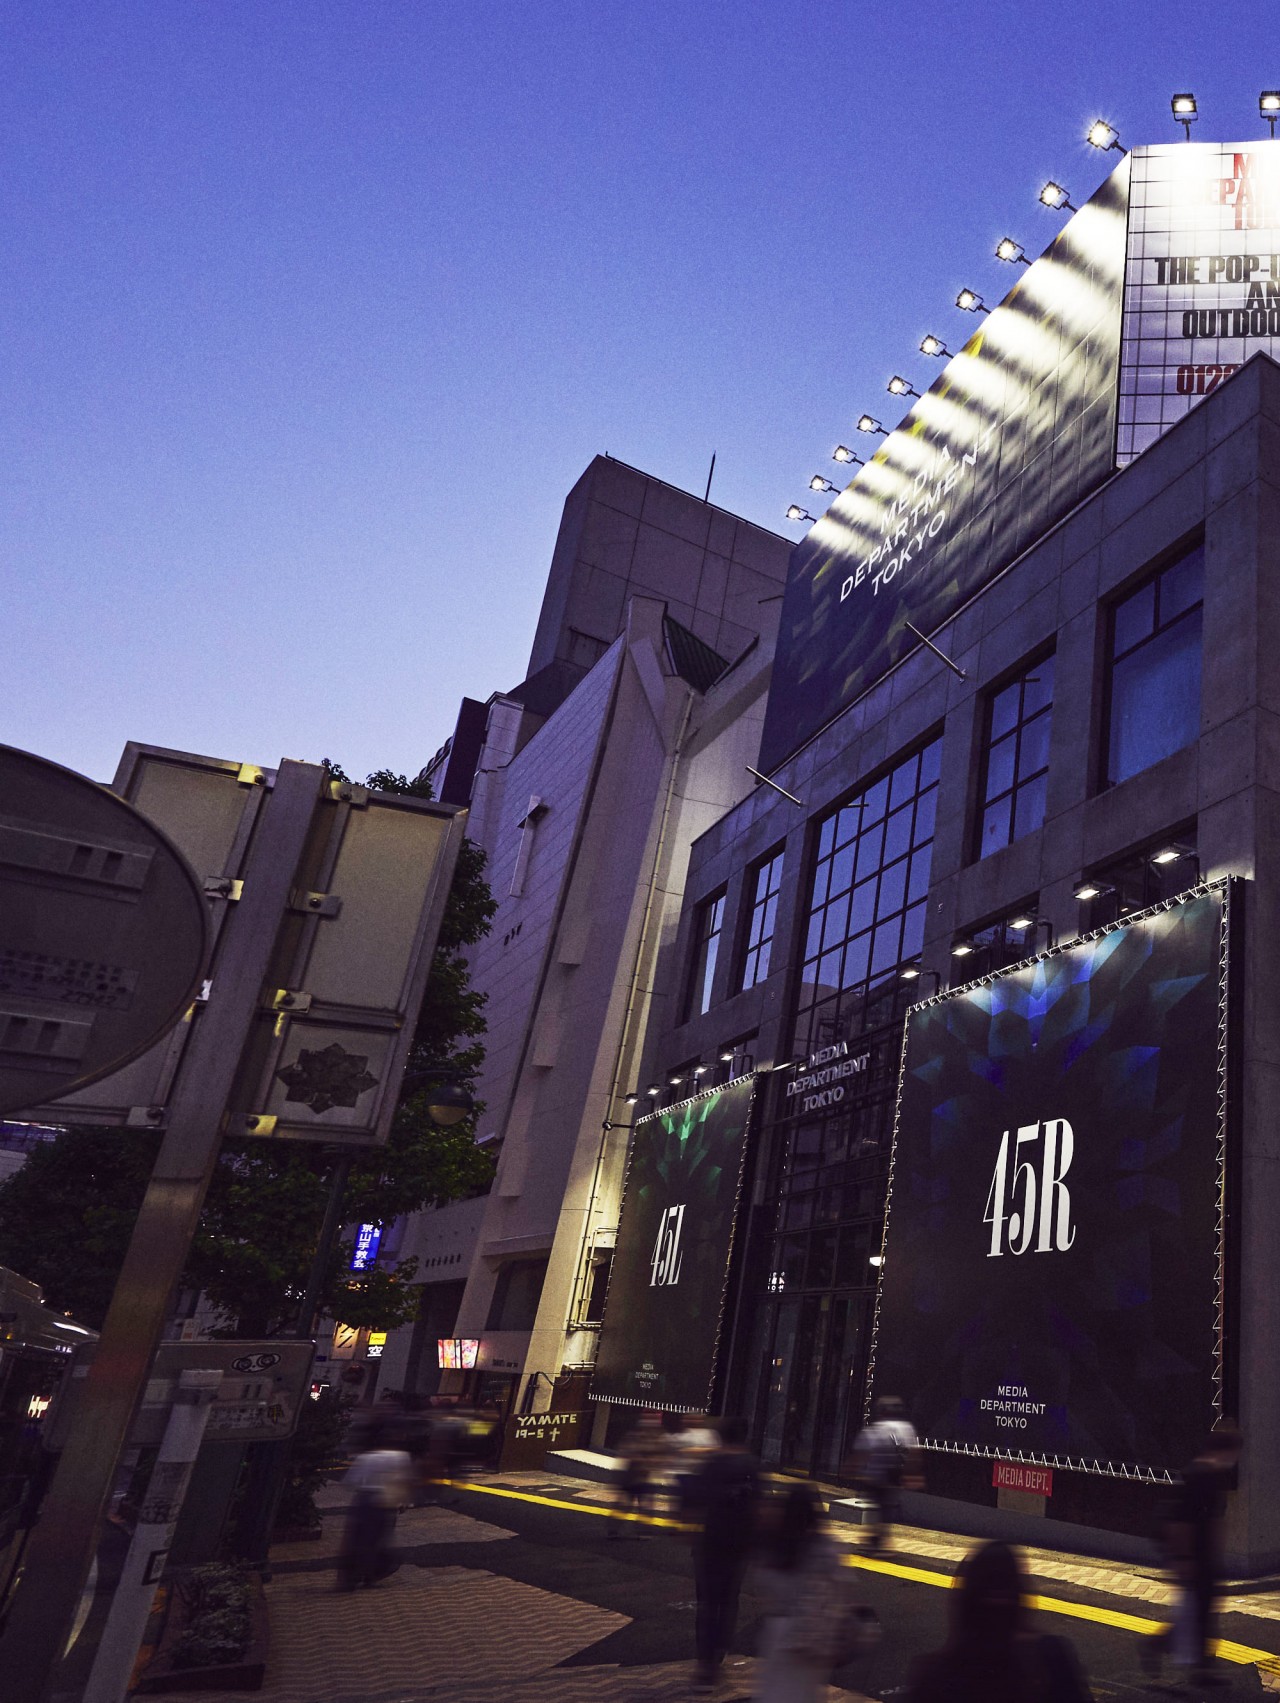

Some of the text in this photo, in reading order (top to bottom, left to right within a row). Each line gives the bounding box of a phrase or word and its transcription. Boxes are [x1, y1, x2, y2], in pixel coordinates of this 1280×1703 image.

[1155, 256, 1200, 285] THE
[840, 421, 997, 603] DEPARTMENT
[871, 510, 946, 596] TOKYO
[808, 1041, 848, 1068] MEDIA
[786, 1052, 870, 1097] DEPARTMENT
[803, 1086, 845, 1112] TOKYO
[982, 1118, 1076, 1257] 45R
[649, 1204, 686, 1286] 45L
[997, 1385, 1028, 1397] MEDIA
[980, 1399, 1046, 1414] DEPARTMENT
[515, 1428, 544, 1438] 19-5
[517, 1414, 577, 1426] YAMATE
[995, 1416, 1027, 1428] TOKYO
[997, 1466, 1049, 1491] MEDIA DEPT.
